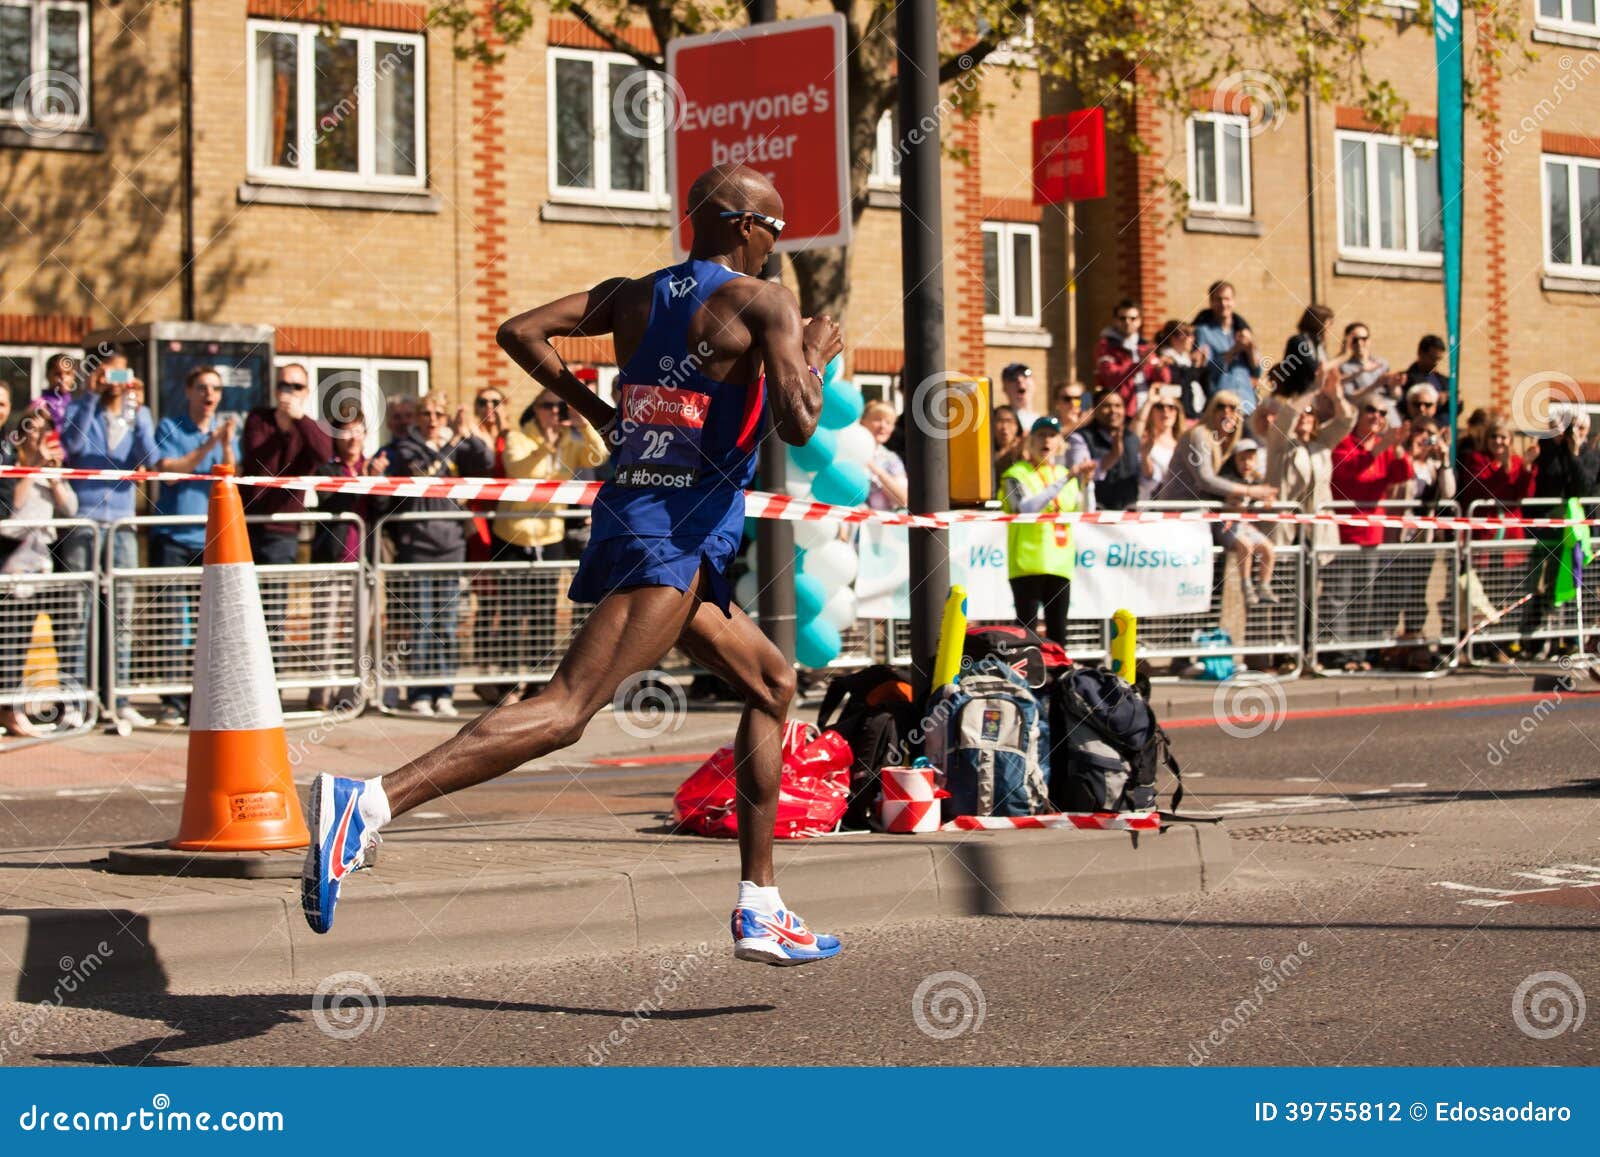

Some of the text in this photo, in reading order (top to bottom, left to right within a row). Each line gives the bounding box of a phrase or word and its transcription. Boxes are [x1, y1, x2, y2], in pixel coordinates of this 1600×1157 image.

[681, 83, 829, 131] Everyone's
[712, 133, 797, 165] better
[657, 400, 704, 419] money
[631, 468, 693, 488] #boost
